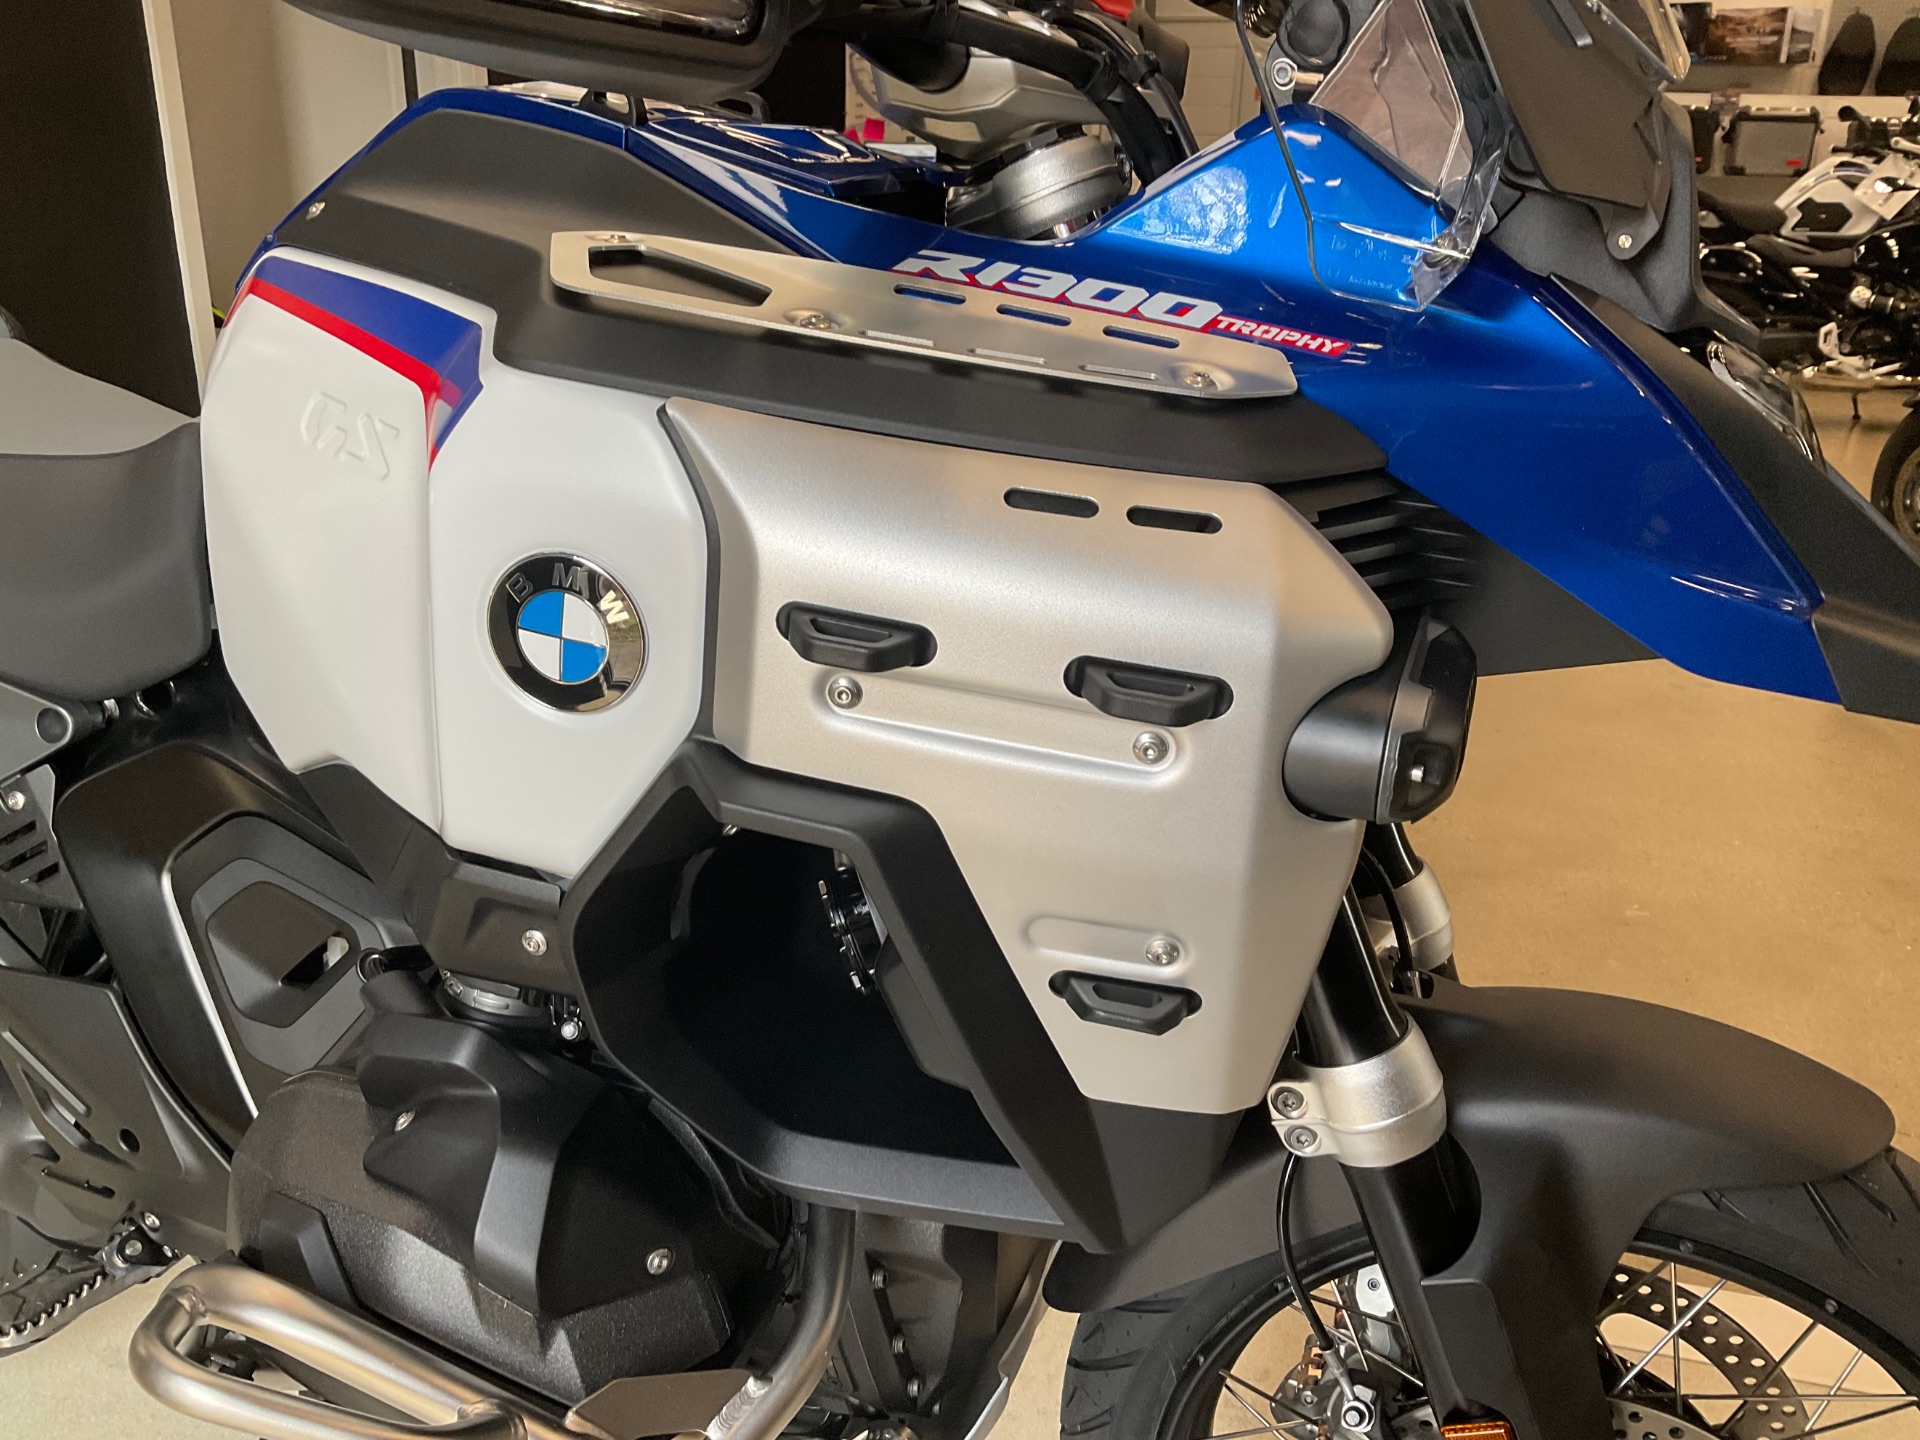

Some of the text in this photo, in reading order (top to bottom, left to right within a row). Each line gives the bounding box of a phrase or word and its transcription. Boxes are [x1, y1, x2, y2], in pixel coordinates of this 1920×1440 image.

[892, 249, 1345, 353] R1300 TROPHY
[300, 390, 401, 481] GS
[505, 562, 630, 625] BMW
